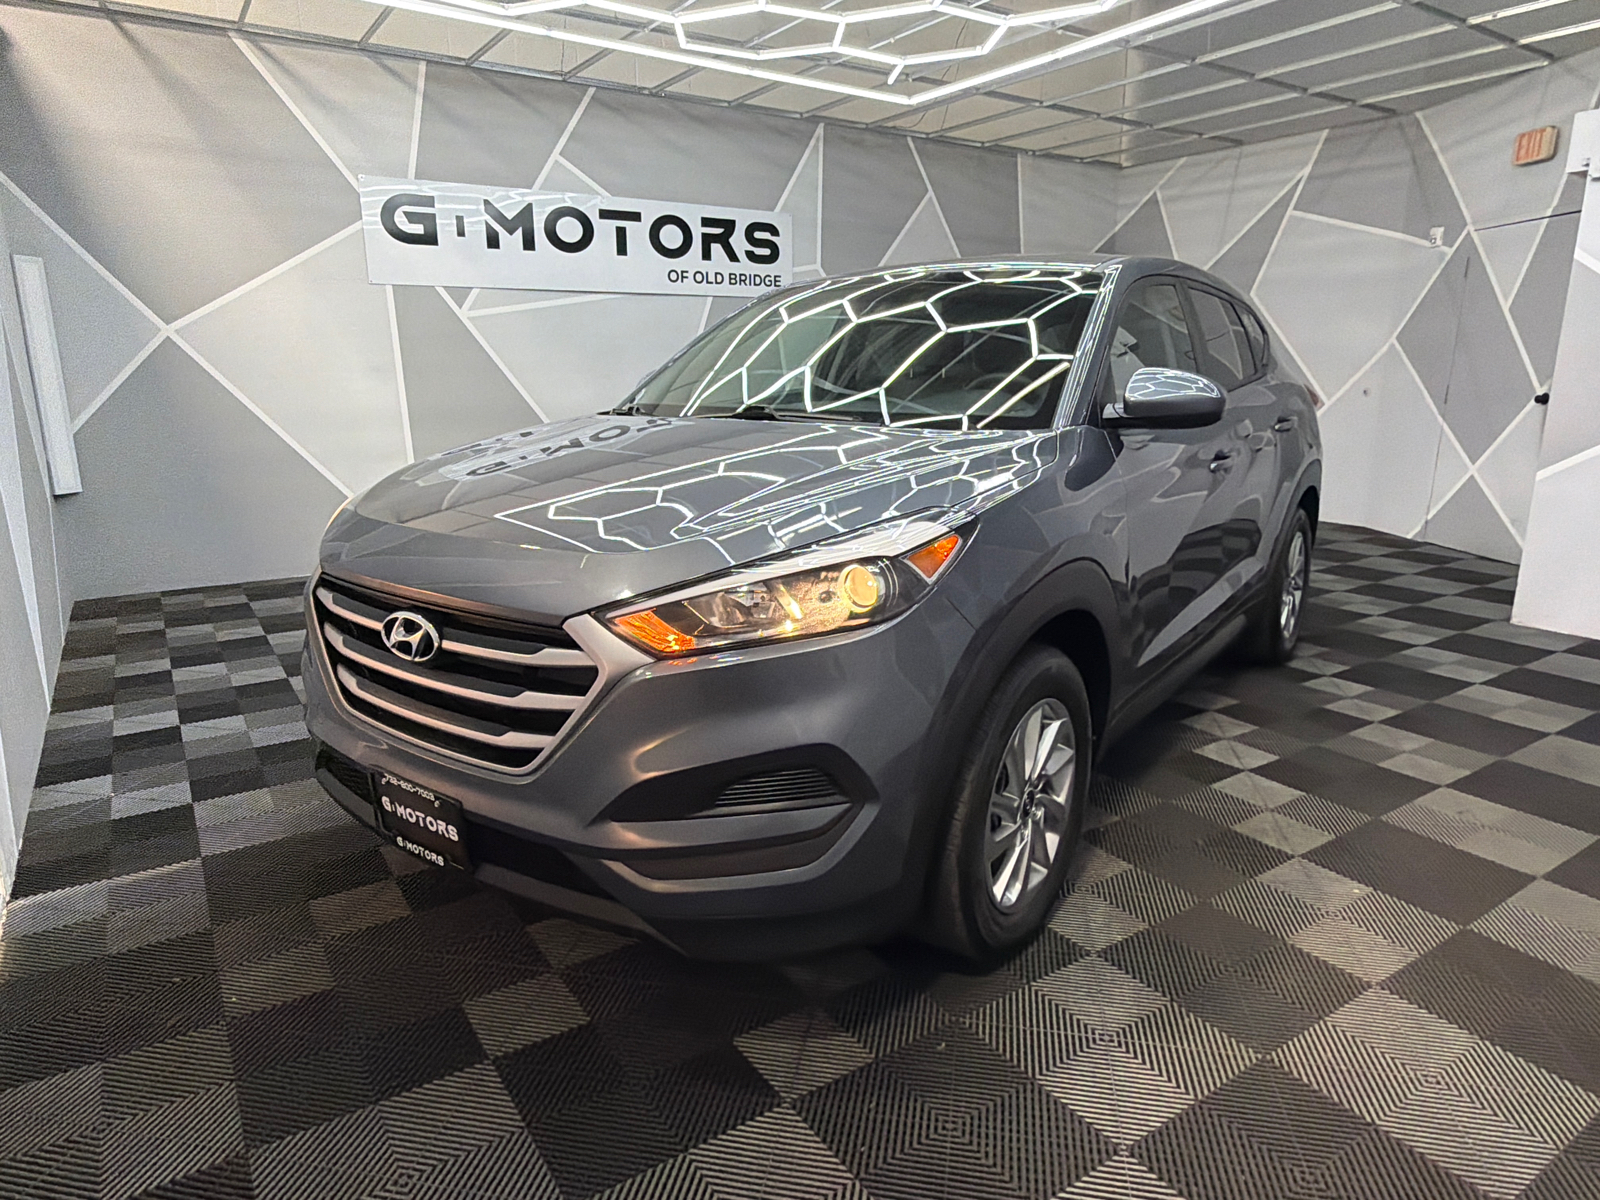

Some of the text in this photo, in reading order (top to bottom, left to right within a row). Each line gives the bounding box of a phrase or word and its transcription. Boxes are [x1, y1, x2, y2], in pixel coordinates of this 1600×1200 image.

[667, 269, 782, 287] OF OLD BRIDGE
